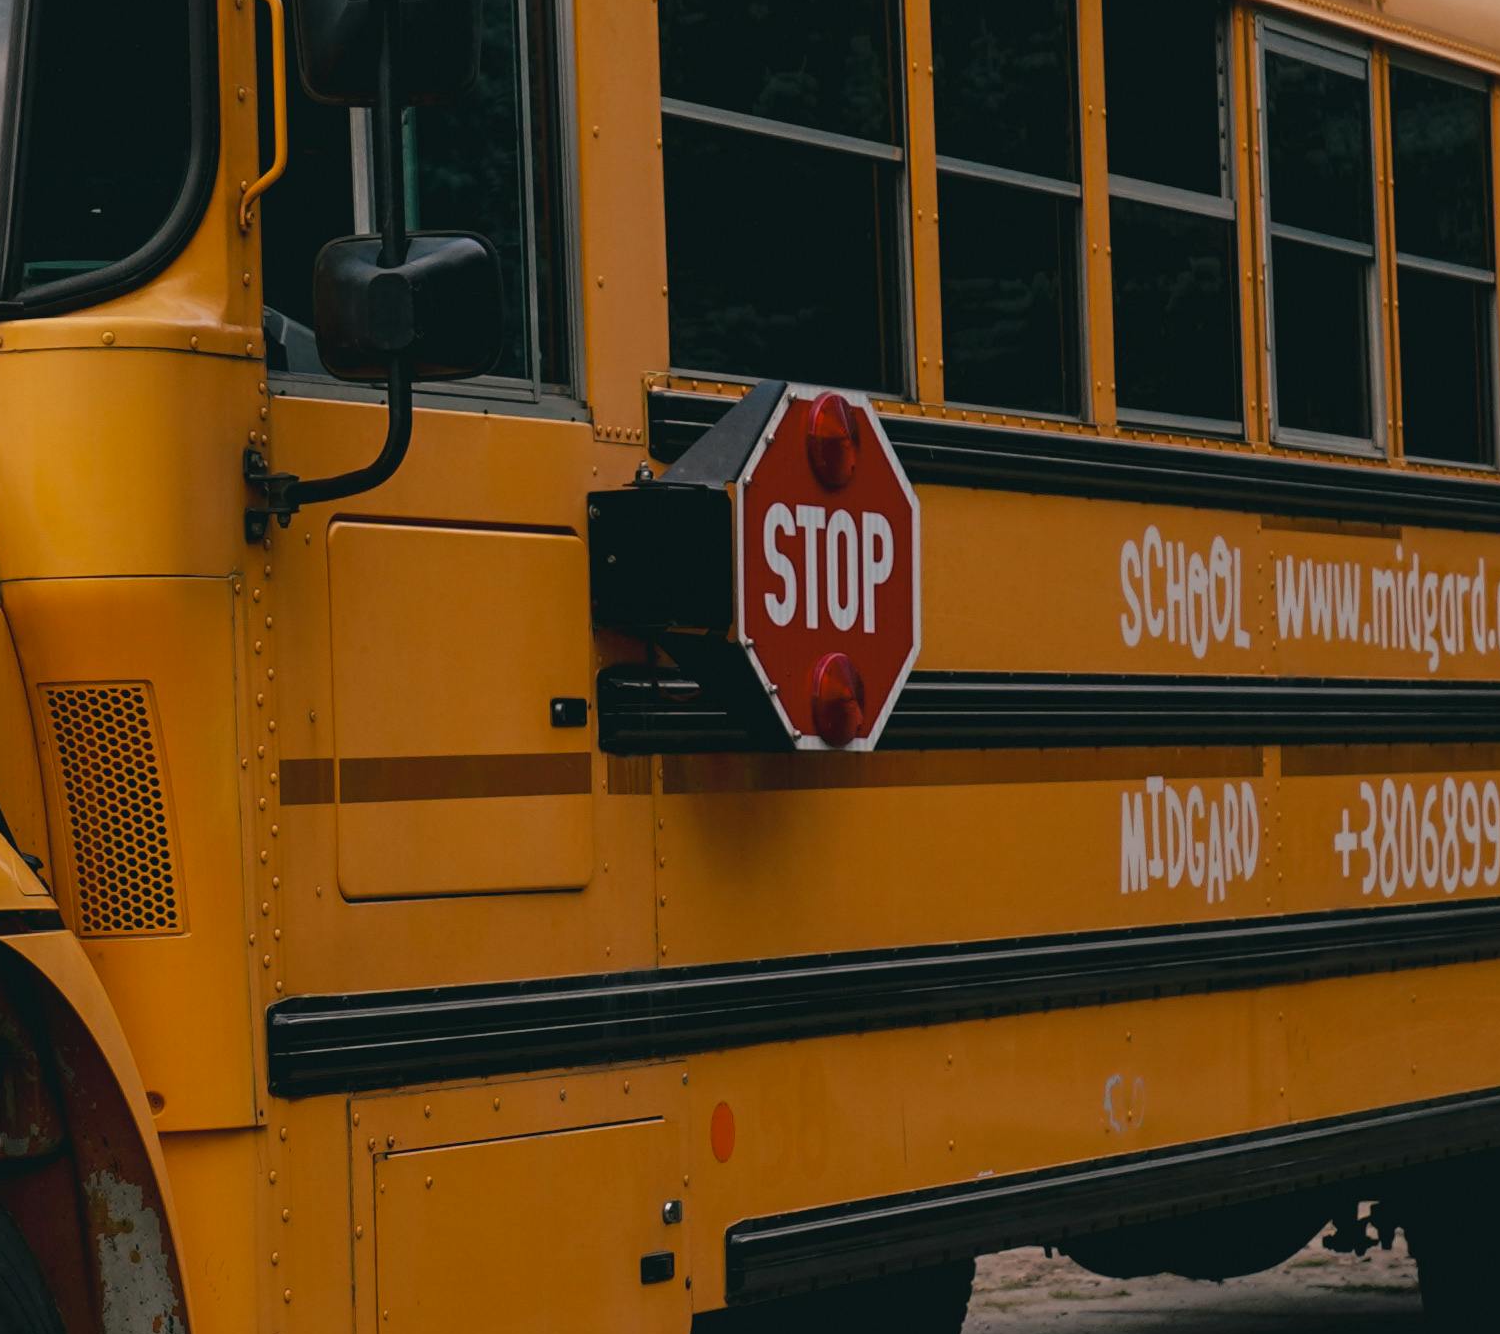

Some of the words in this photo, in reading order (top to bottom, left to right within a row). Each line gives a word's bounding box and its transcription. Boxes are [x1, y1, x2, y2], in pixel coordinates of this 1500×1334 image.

[763, 502, 894, 634] STOP
[1120, 524, 1251, 659] SCHOOL
[1121, 775, 1260, 903] MIDGARD
